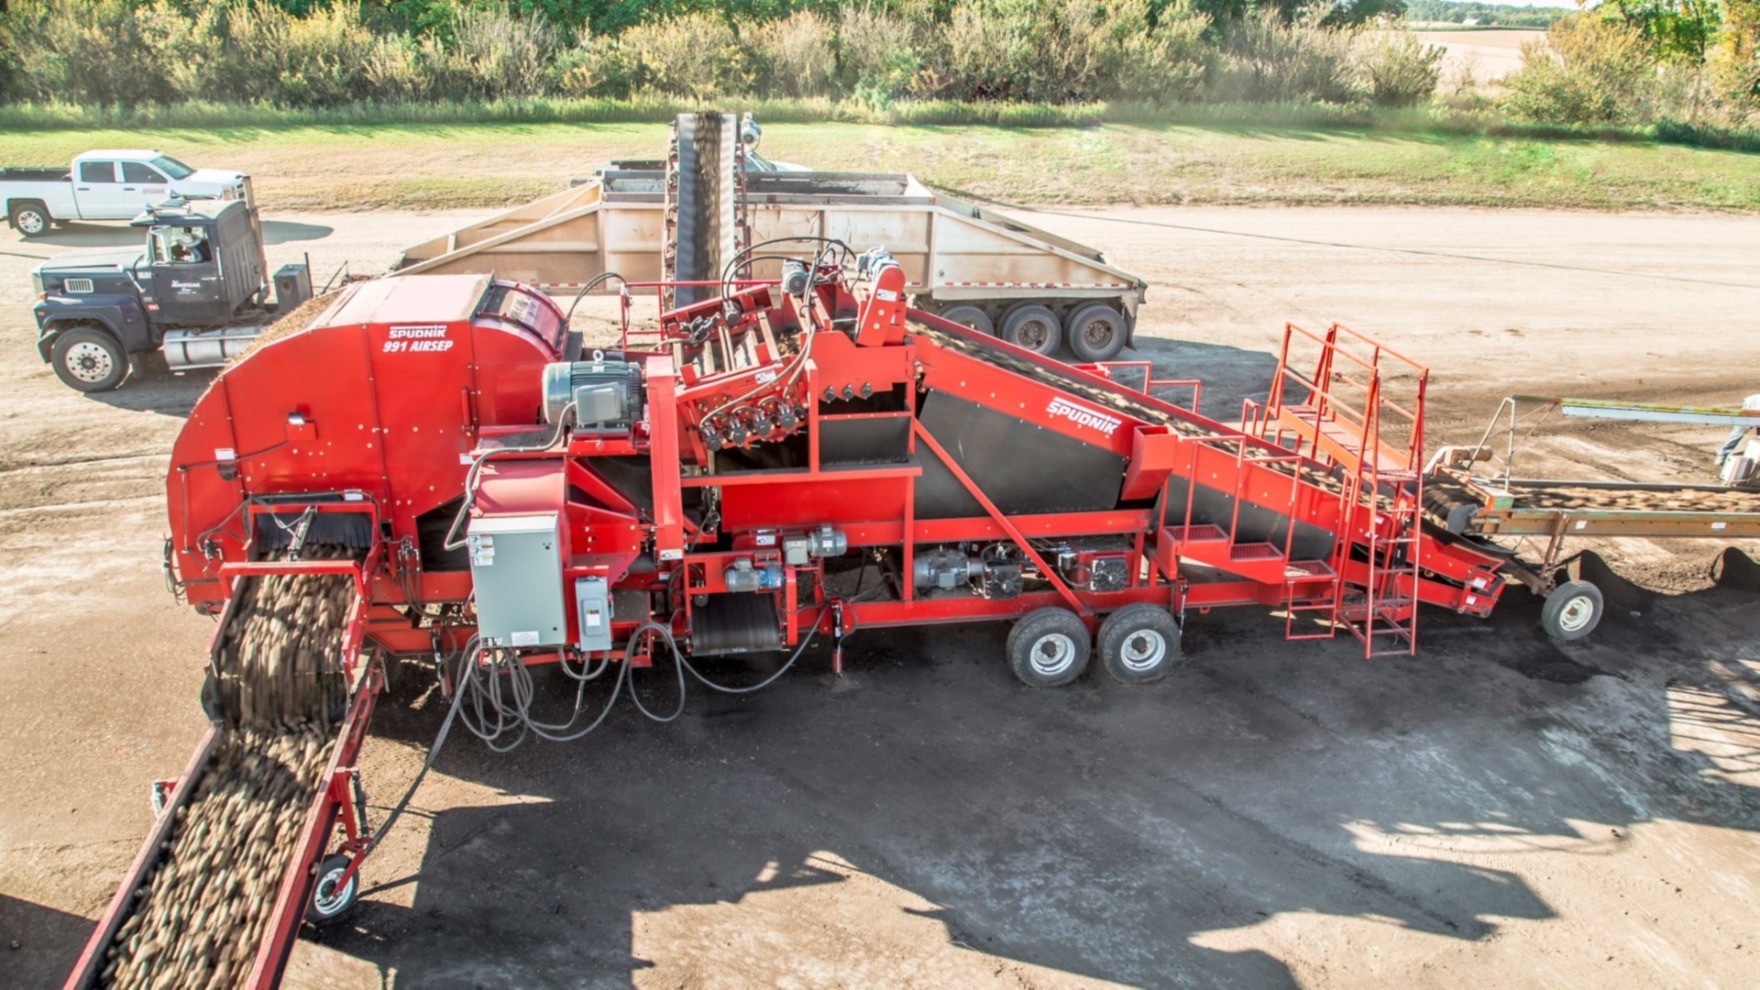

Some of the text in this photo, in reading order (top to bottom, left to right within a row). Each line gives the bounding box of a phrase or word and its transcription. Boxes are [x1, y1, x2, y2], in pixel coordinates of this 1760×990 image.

[389, 325, 447, 339] SPUDNIK
[383, 340, 453, 352] 991 AIRSEP
[1046, 397, 1121, 434] SPUDNIK
